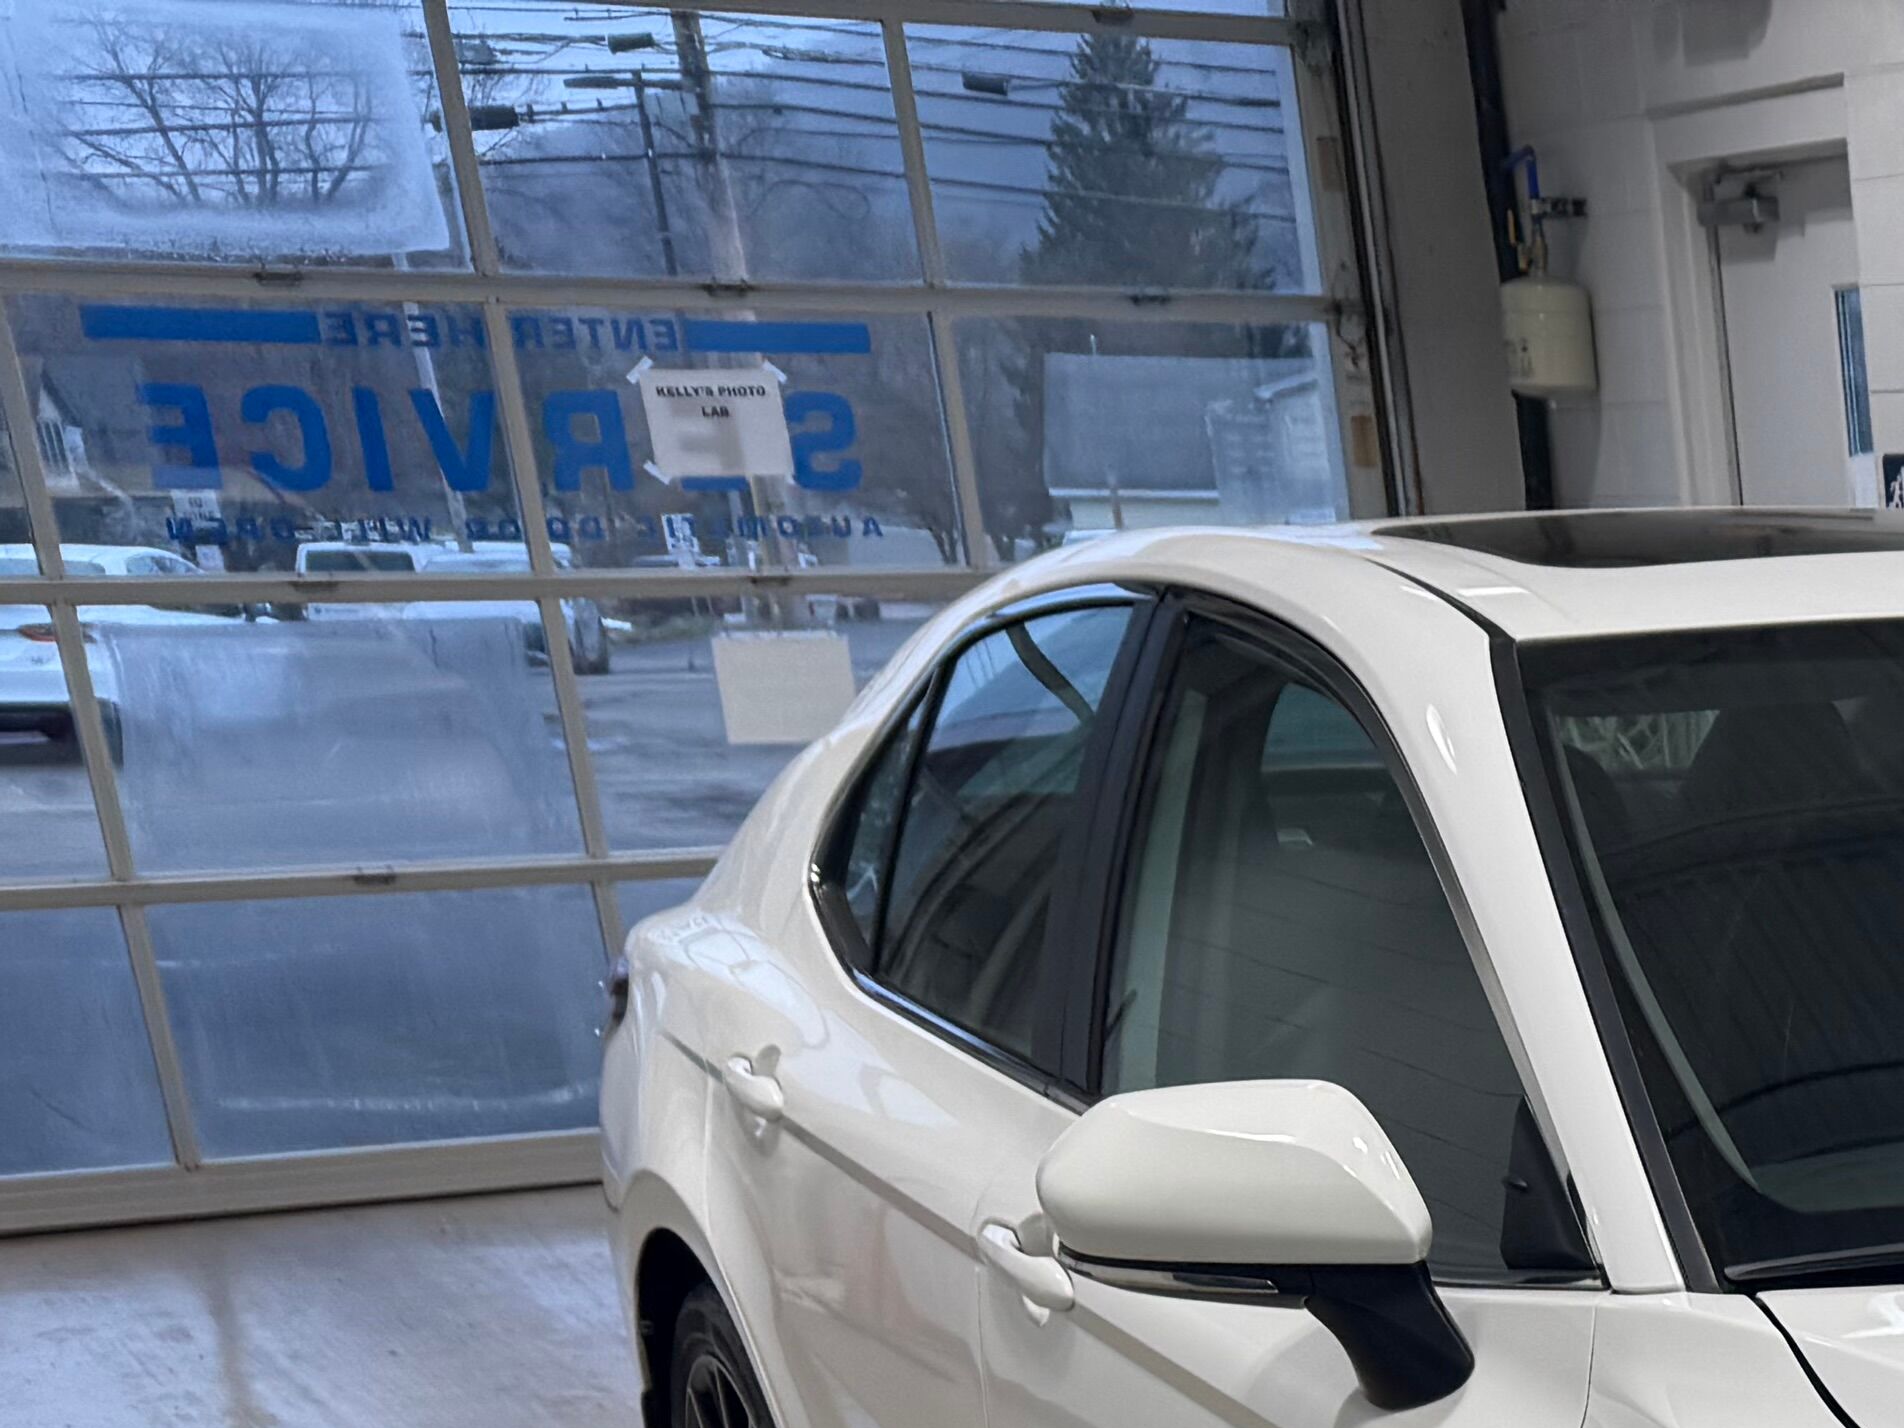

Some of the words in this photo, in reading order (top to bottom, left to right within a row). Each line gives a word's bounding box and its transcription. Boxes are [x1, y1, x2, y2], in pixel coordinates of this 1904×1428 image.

[656, 386, 714, 397] KELLY'S
[718, 385, 766, 397] PHOTO
[702, 406, 729, 417] LAB
